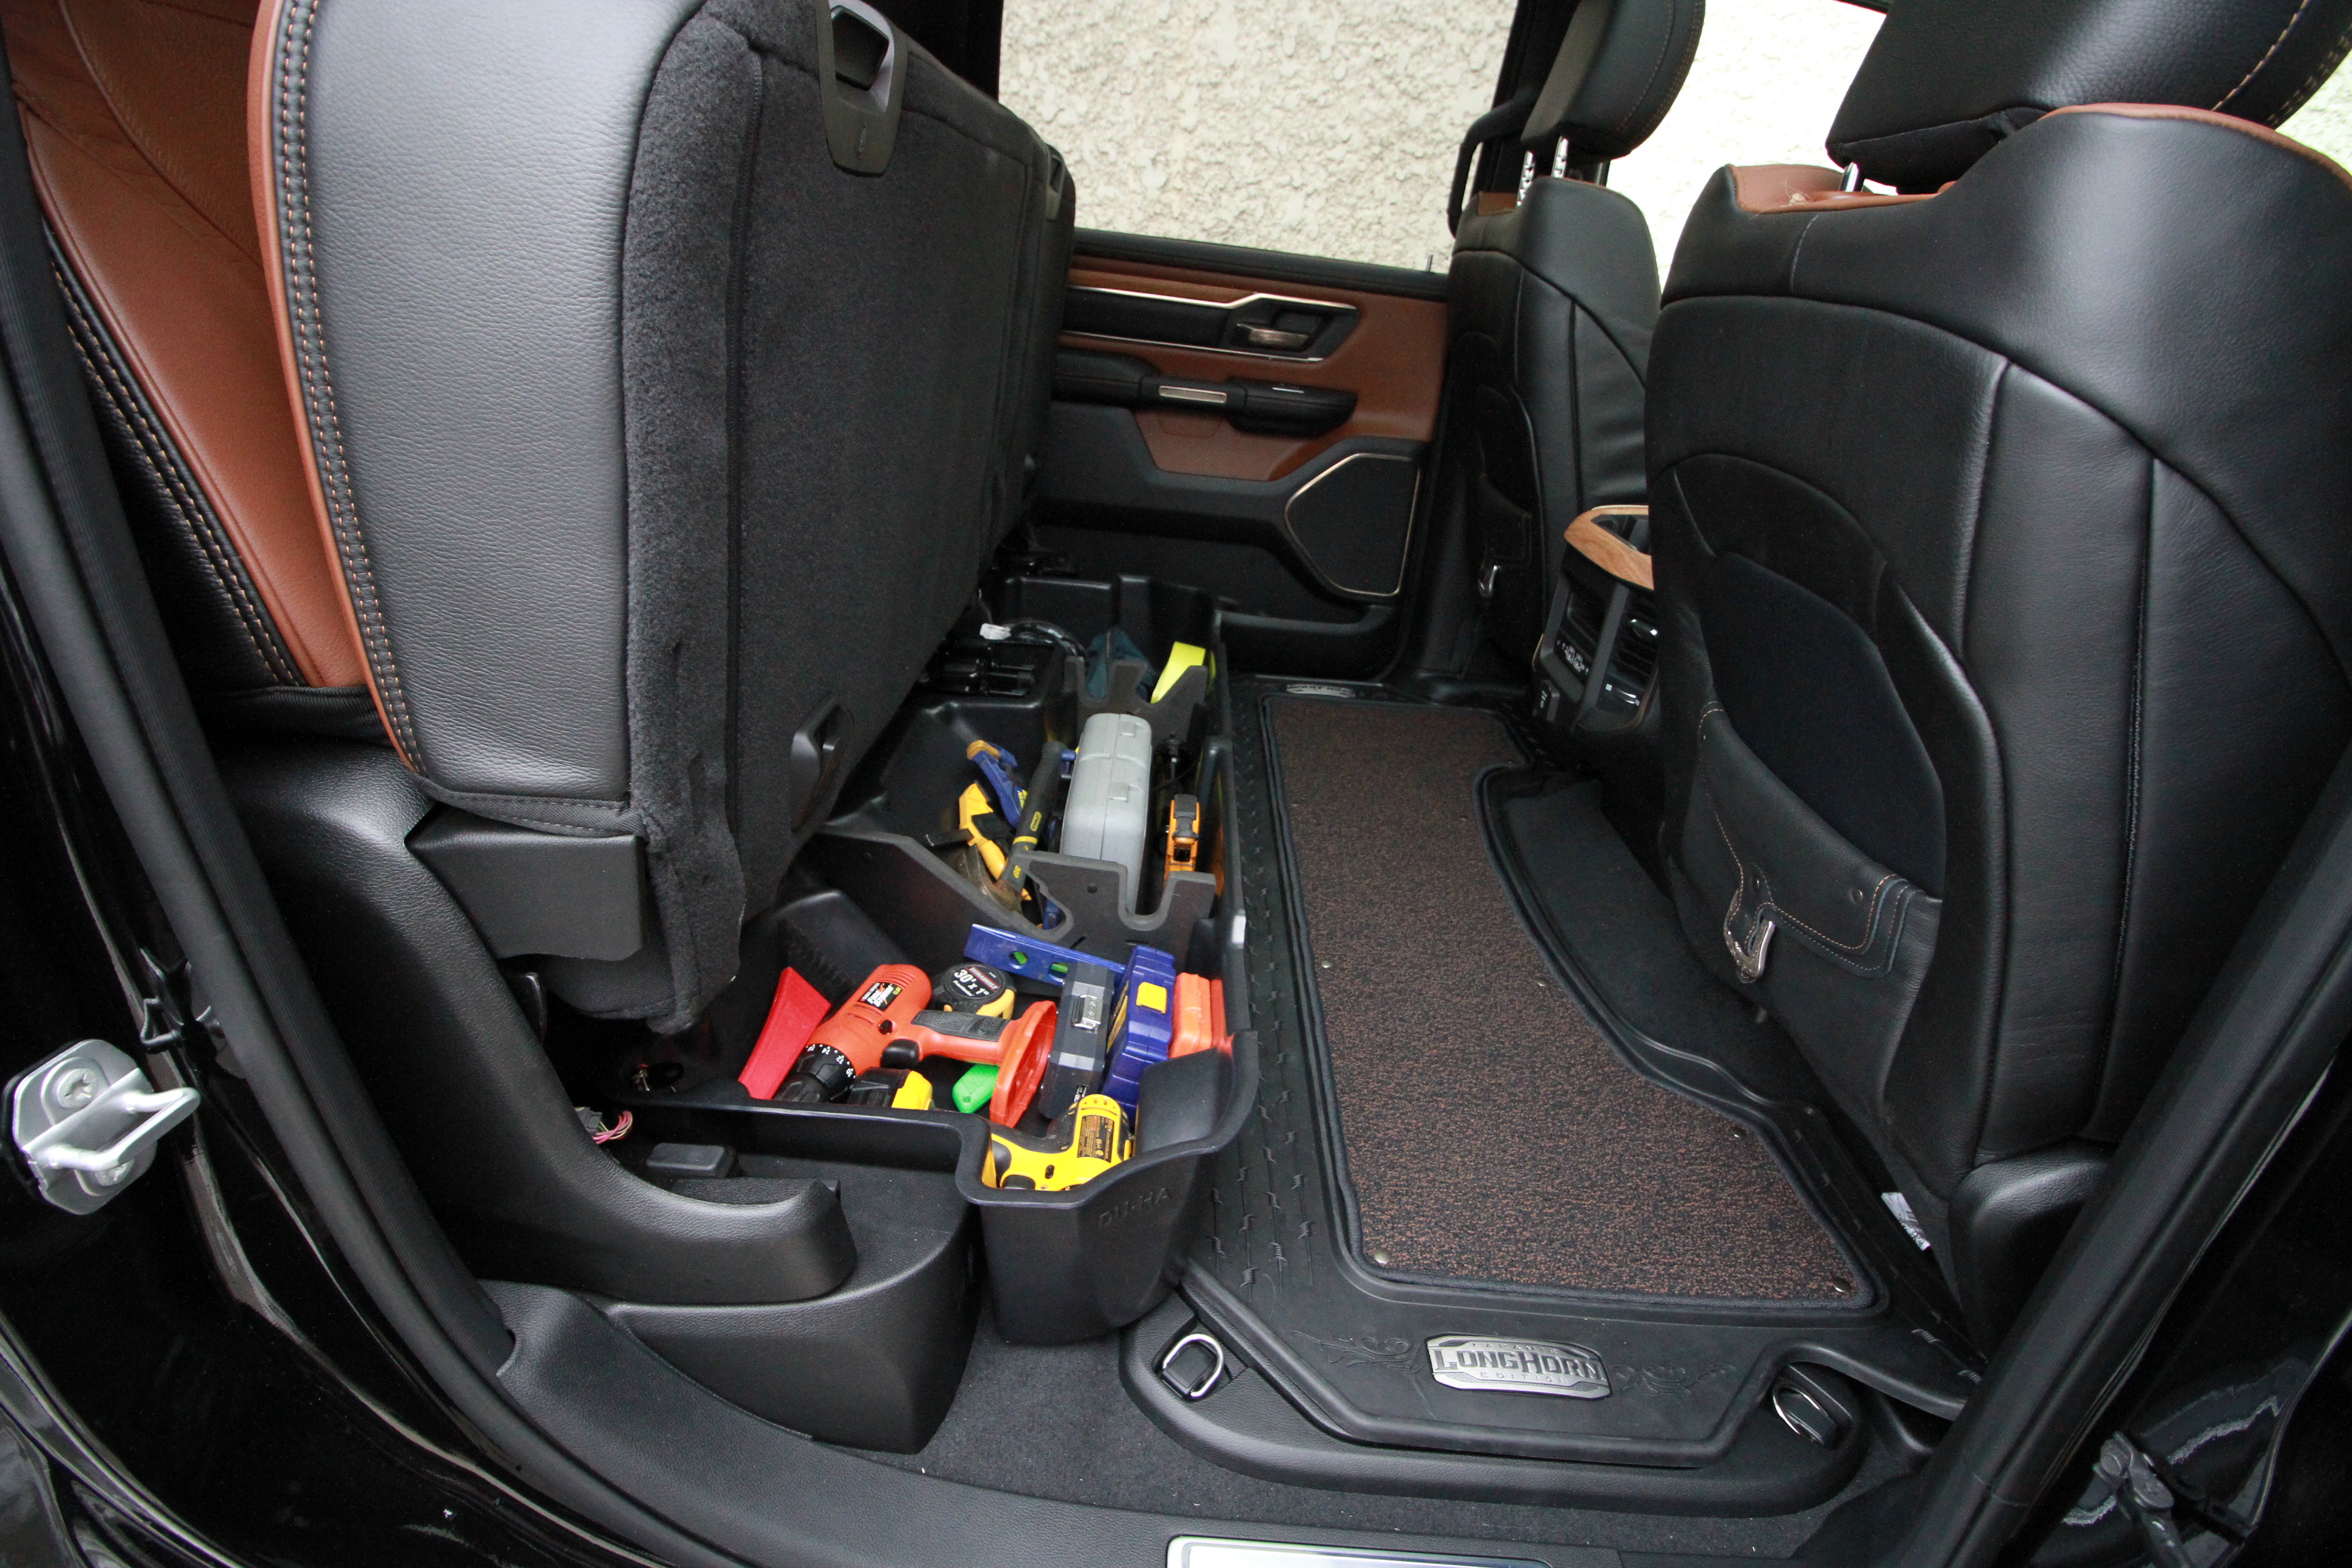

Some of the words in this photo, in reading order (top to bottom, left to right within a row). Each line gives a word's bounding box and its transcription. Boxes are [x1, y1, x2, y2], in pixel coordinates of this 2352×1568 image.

[953, 969, 977, 983] 30'
[836, 1055, 845, 1064] 12
[846, 1068, 854, 1077] 10
[1432, 1349, 1607, 1382] LONGHORN
[1481, 1371, 1568, 1384] EDITION
